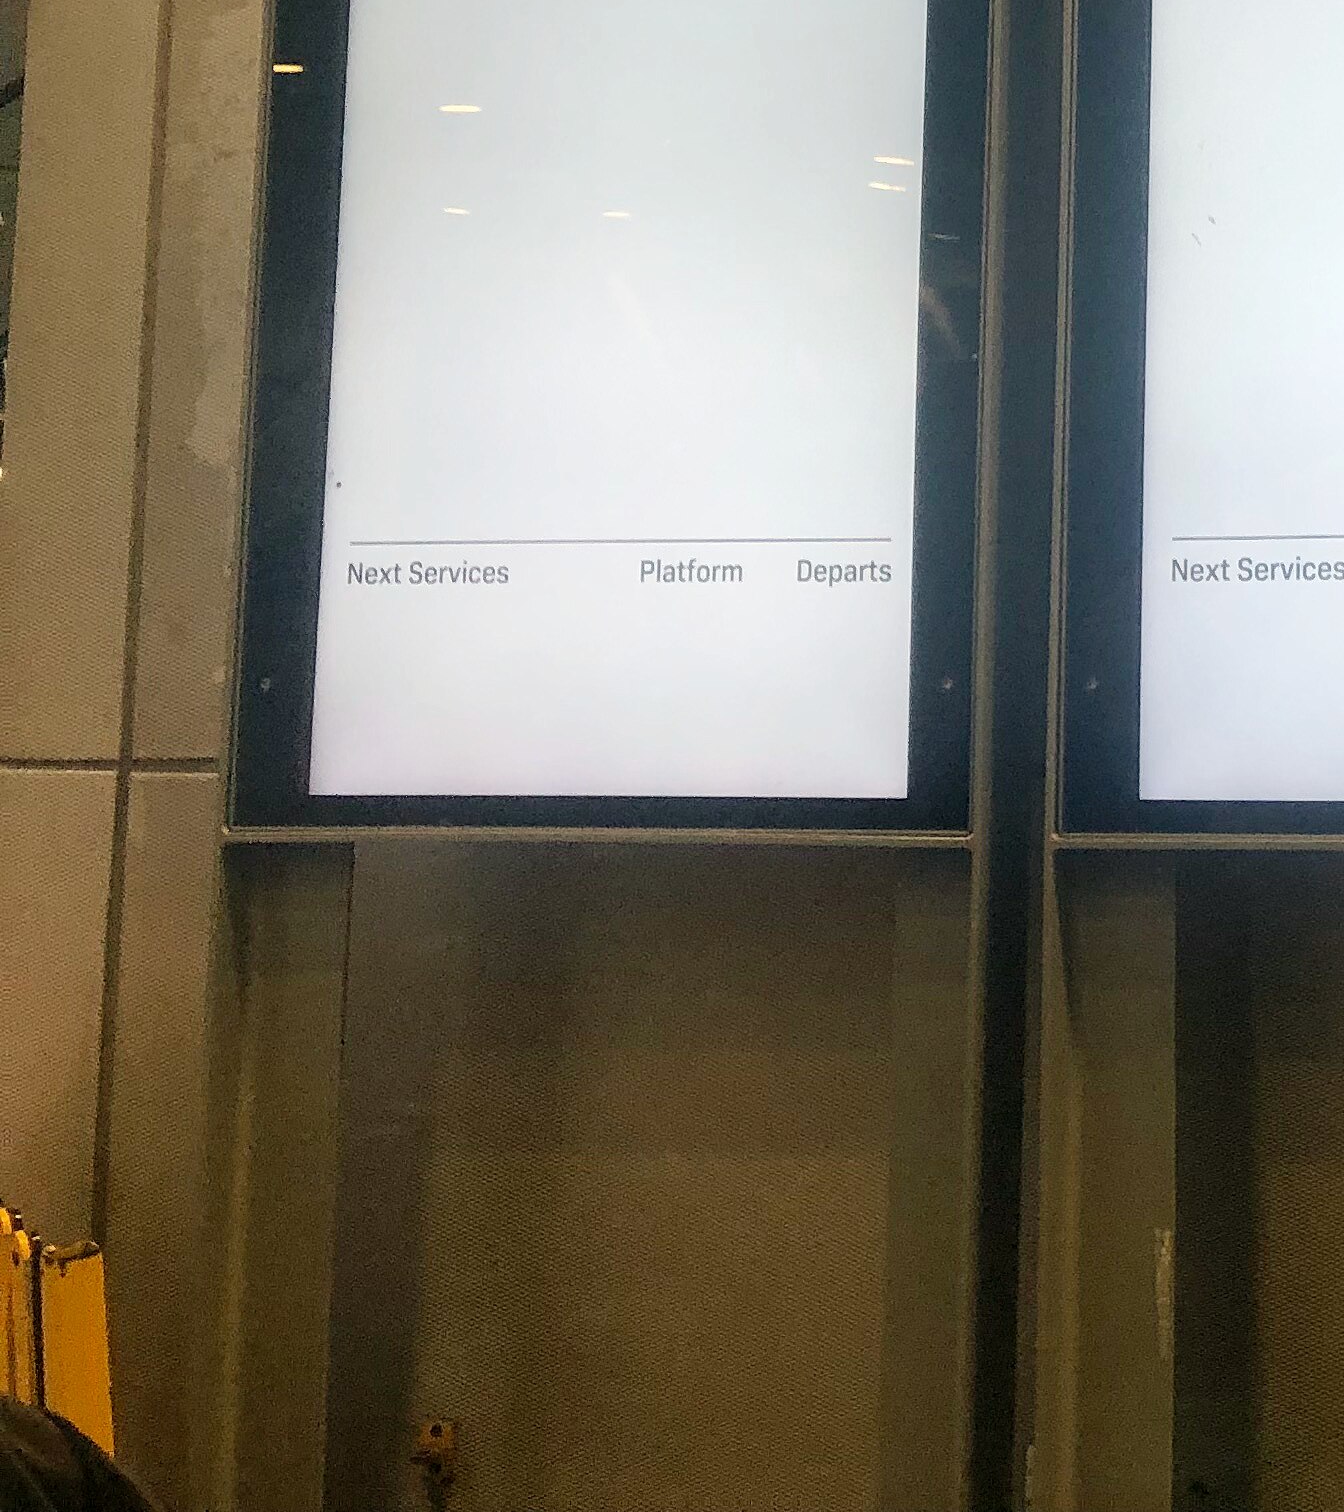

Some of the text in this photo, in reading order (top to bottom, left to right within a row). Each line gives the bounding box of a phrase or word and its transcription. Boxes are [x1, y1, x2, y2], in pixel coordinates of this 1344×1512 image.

[347, 560, 509, 585] Next Services
[640, 557, 743, 583] Platform
[797, 559, 892, 587] Departs
[1171, 558, 1230, 583] Next
